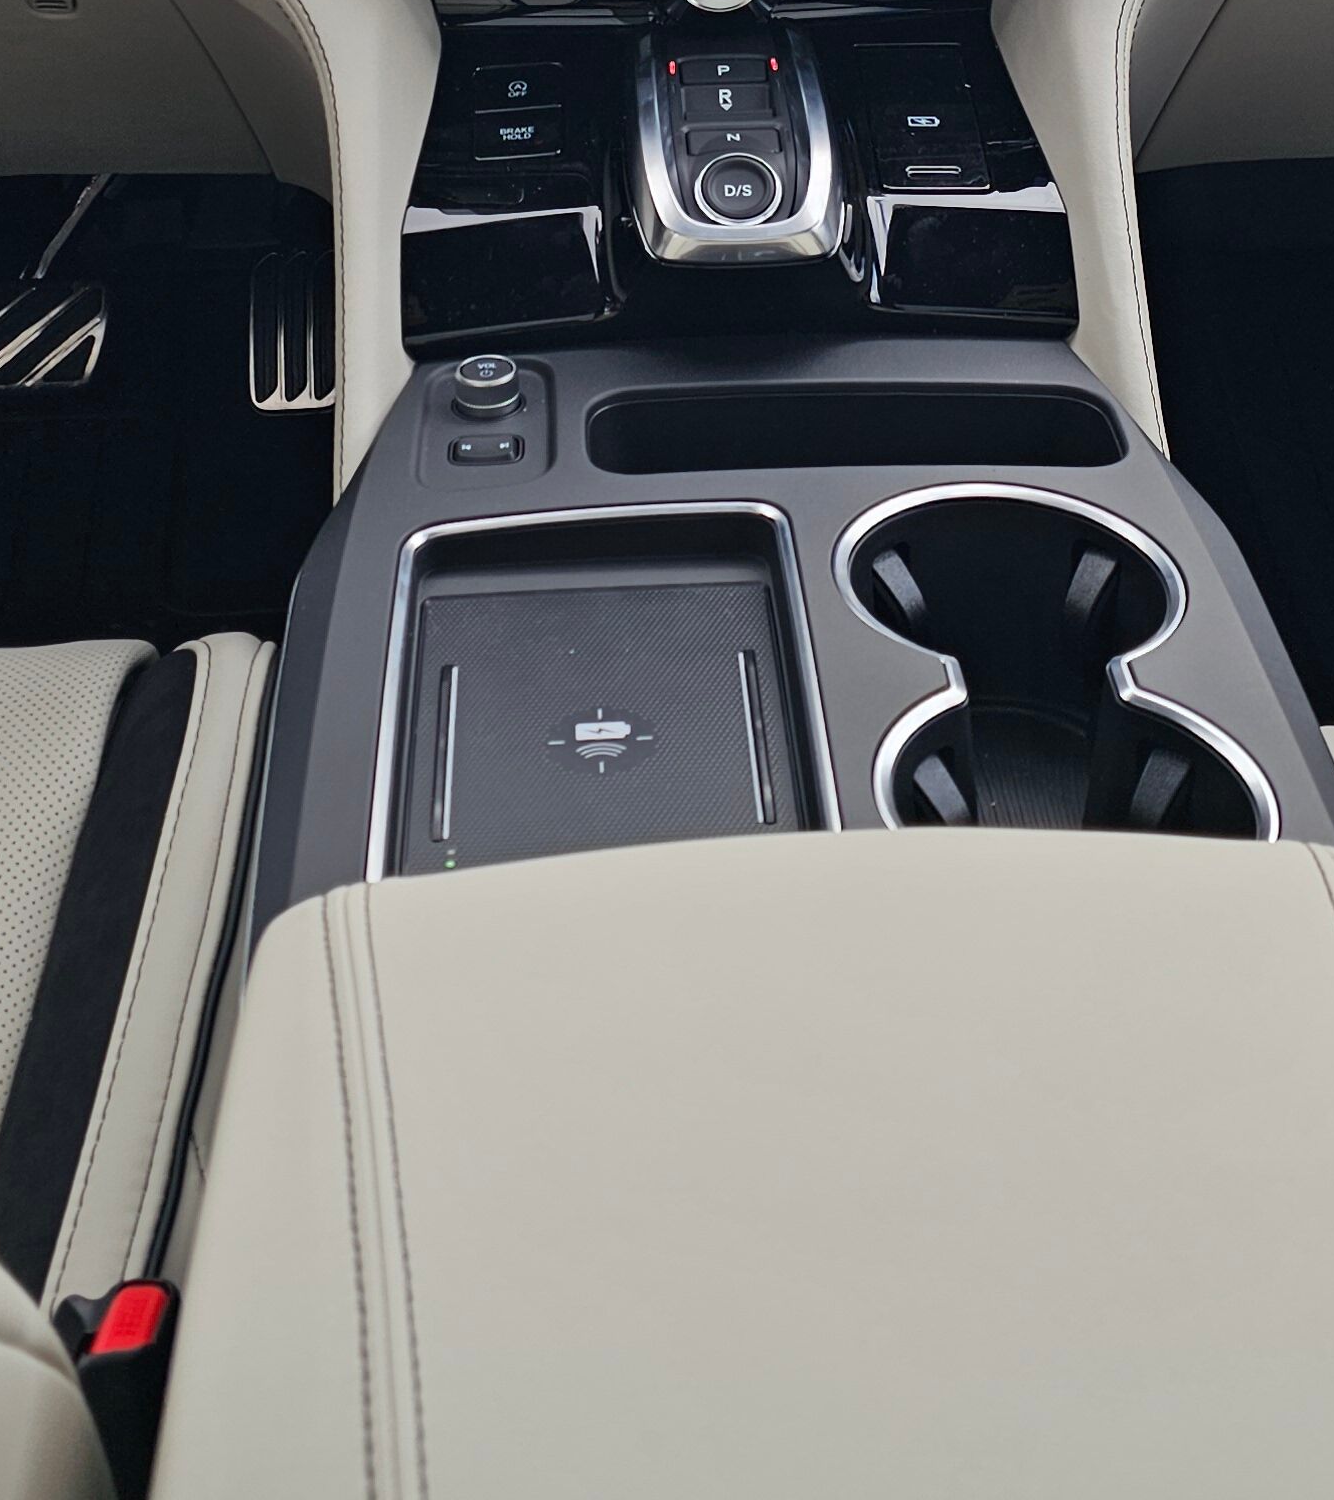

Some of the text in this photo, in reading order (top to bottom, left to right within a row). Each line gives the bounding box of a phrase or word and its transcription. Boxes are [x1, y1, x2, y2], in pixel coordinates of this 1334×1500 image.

[717, 65, 730, 76] P
[508, 90, 527, 98] OFF
[718, 88, 732, 104] R
[499, 126, 535, 135] BRAKE
[503, 132, 531, 140] HOLD
[726, 133, 741, 142] N
[724, 184, 753, 197] D/S
[477, 362, 497, 370] VOL
